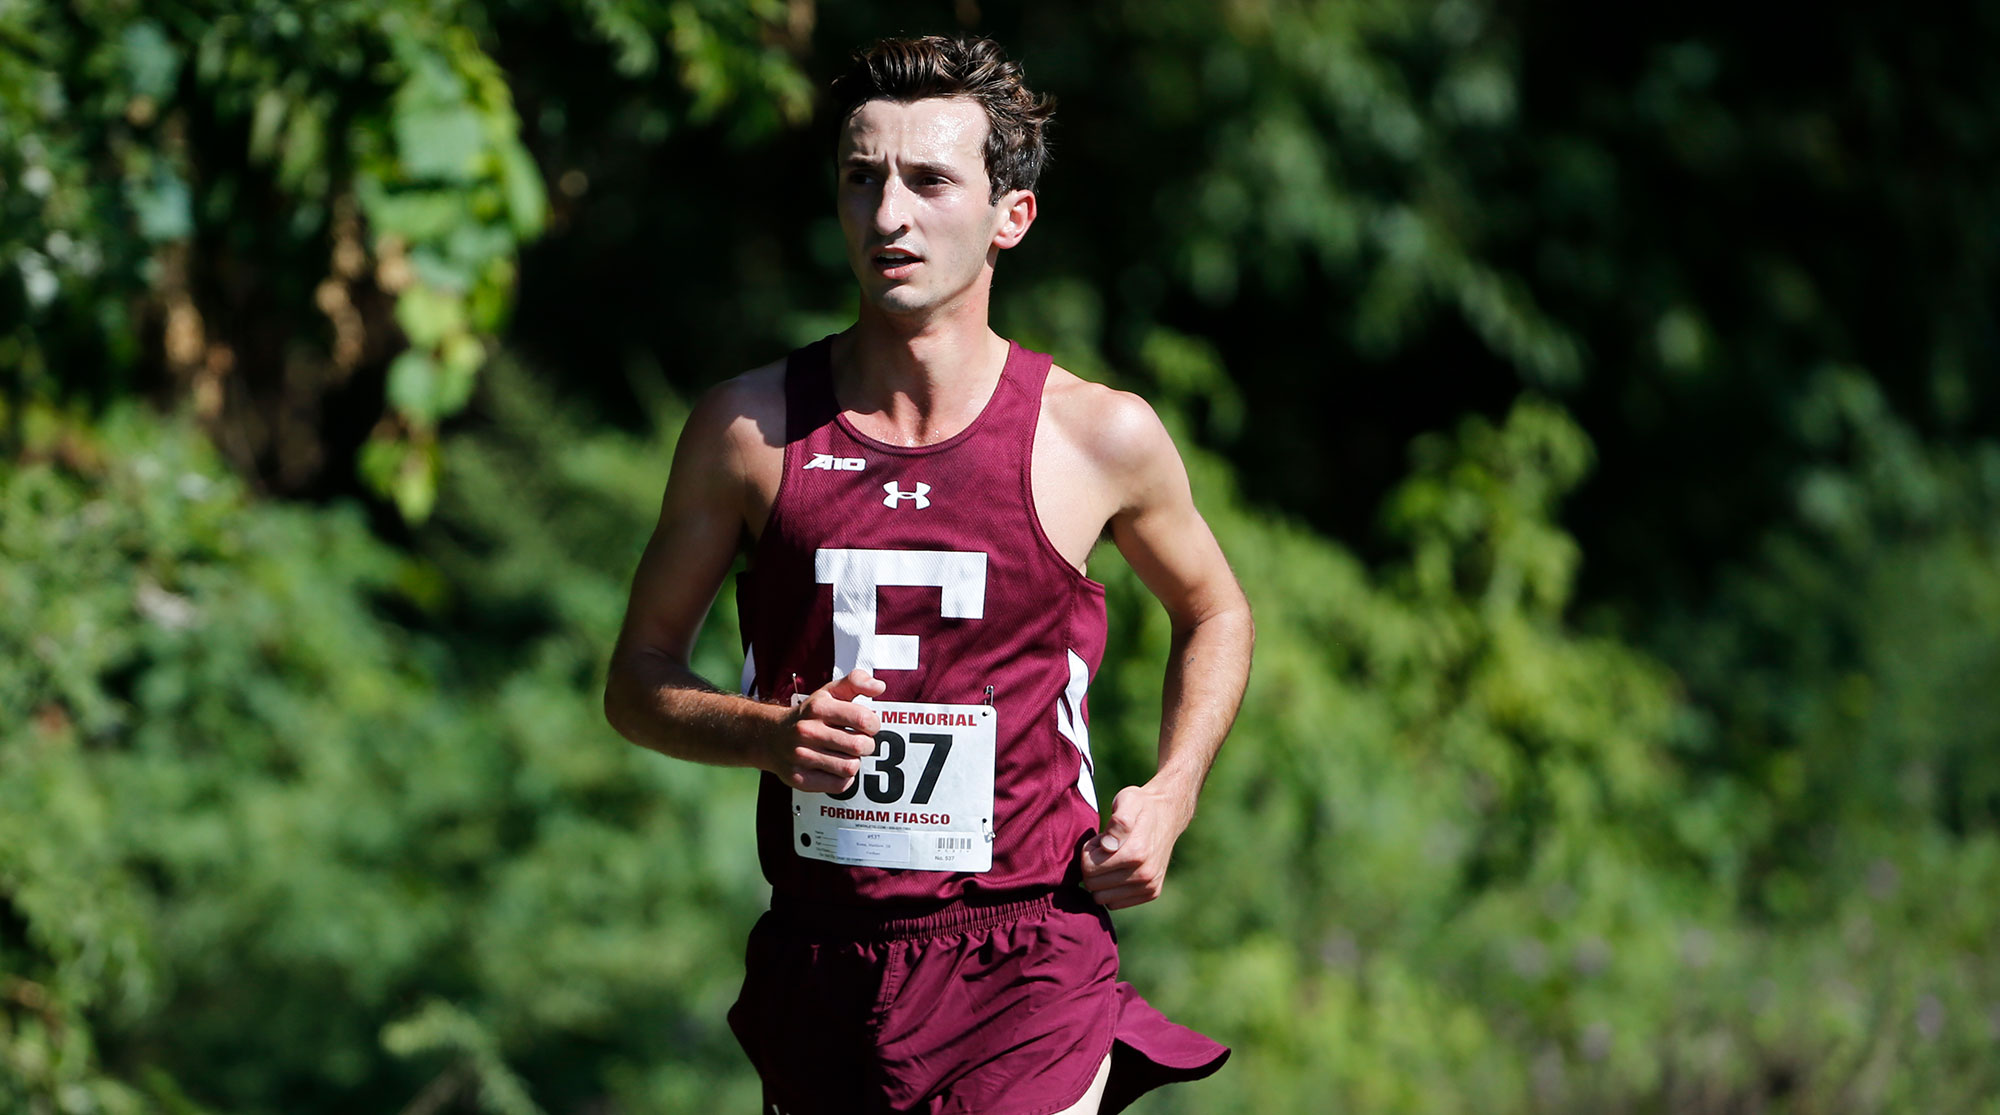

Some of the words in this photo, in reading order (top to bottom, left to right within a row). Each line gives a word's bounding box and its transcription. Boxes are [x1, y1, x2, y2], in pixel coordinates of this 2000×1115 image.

[803, 453, 867, 472] A10
[814, 548, 988, 700] F
[881, 711, 977, 727] MEMORIAL
[824, 730, 953, 805] 37
[820, 805, 890, 823] FORDHAM
[893, 811, 951, 825] FIASCO
